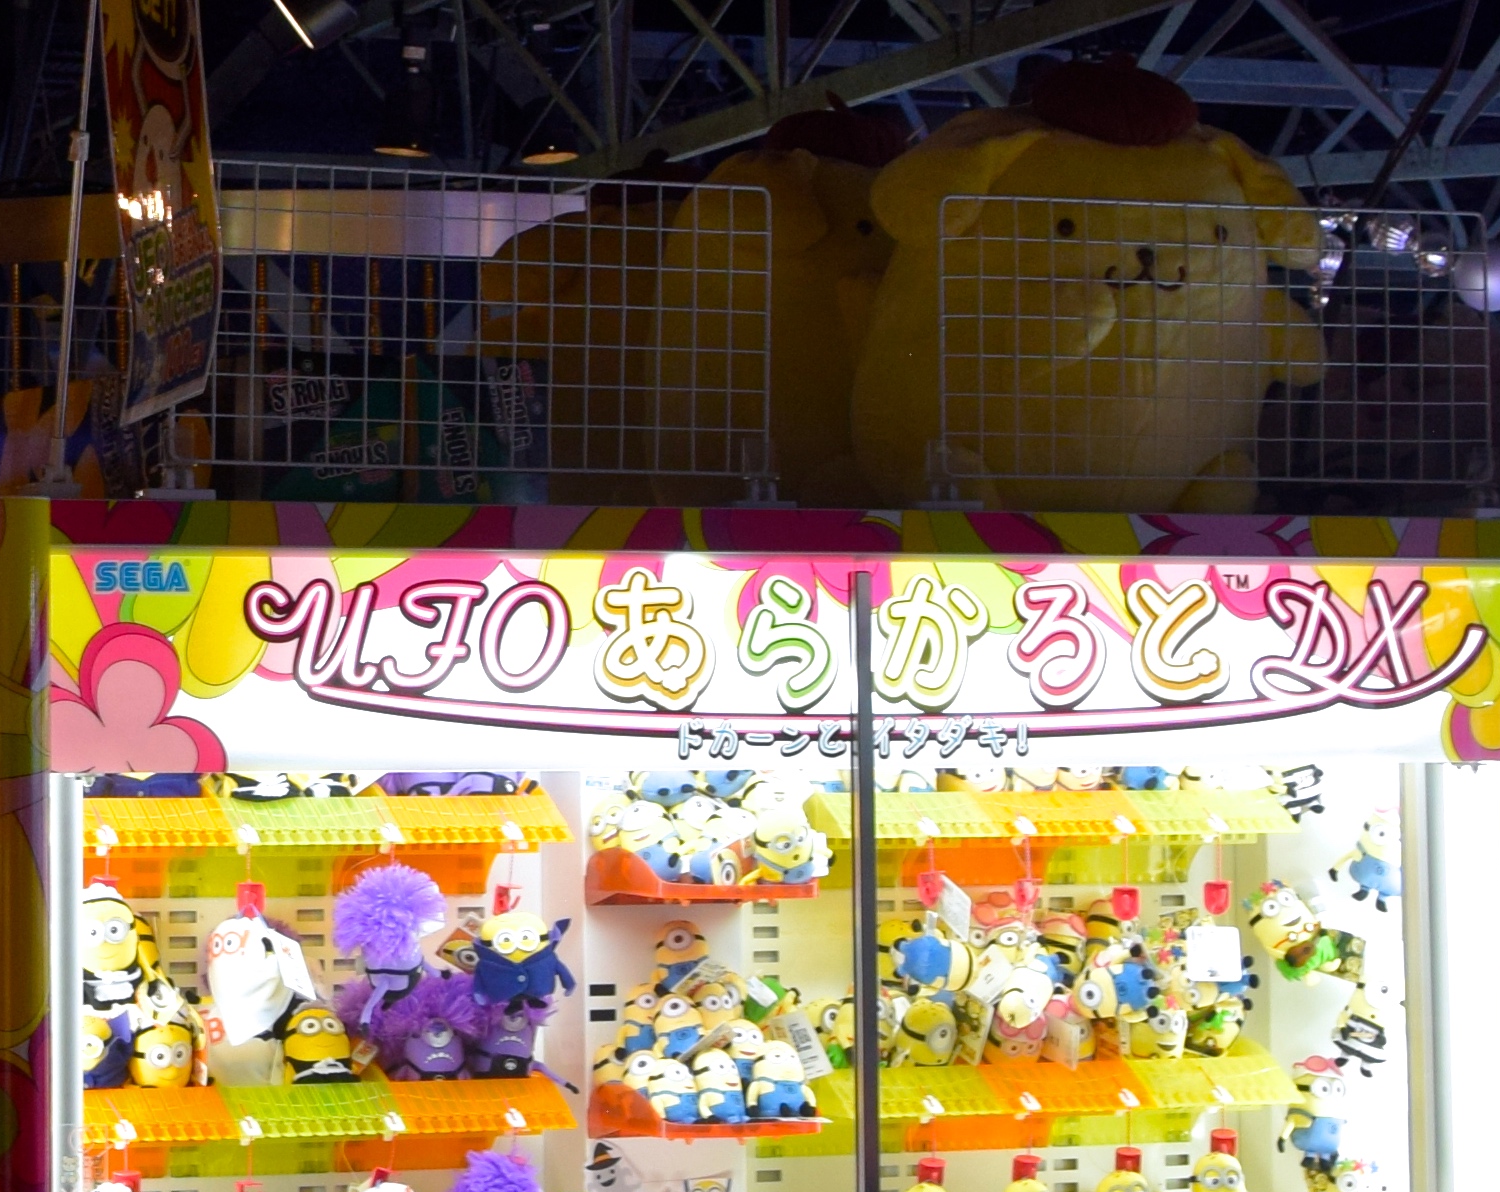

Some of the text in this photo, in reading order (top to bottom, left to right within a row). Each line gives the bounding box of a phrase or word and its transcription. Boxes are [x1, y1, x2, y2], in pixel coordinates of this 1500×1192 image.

[95, 561, 188, 593] SEGA
[246, 578, 570, 692] UFO
[1252, 578, 1488, 711] DX
